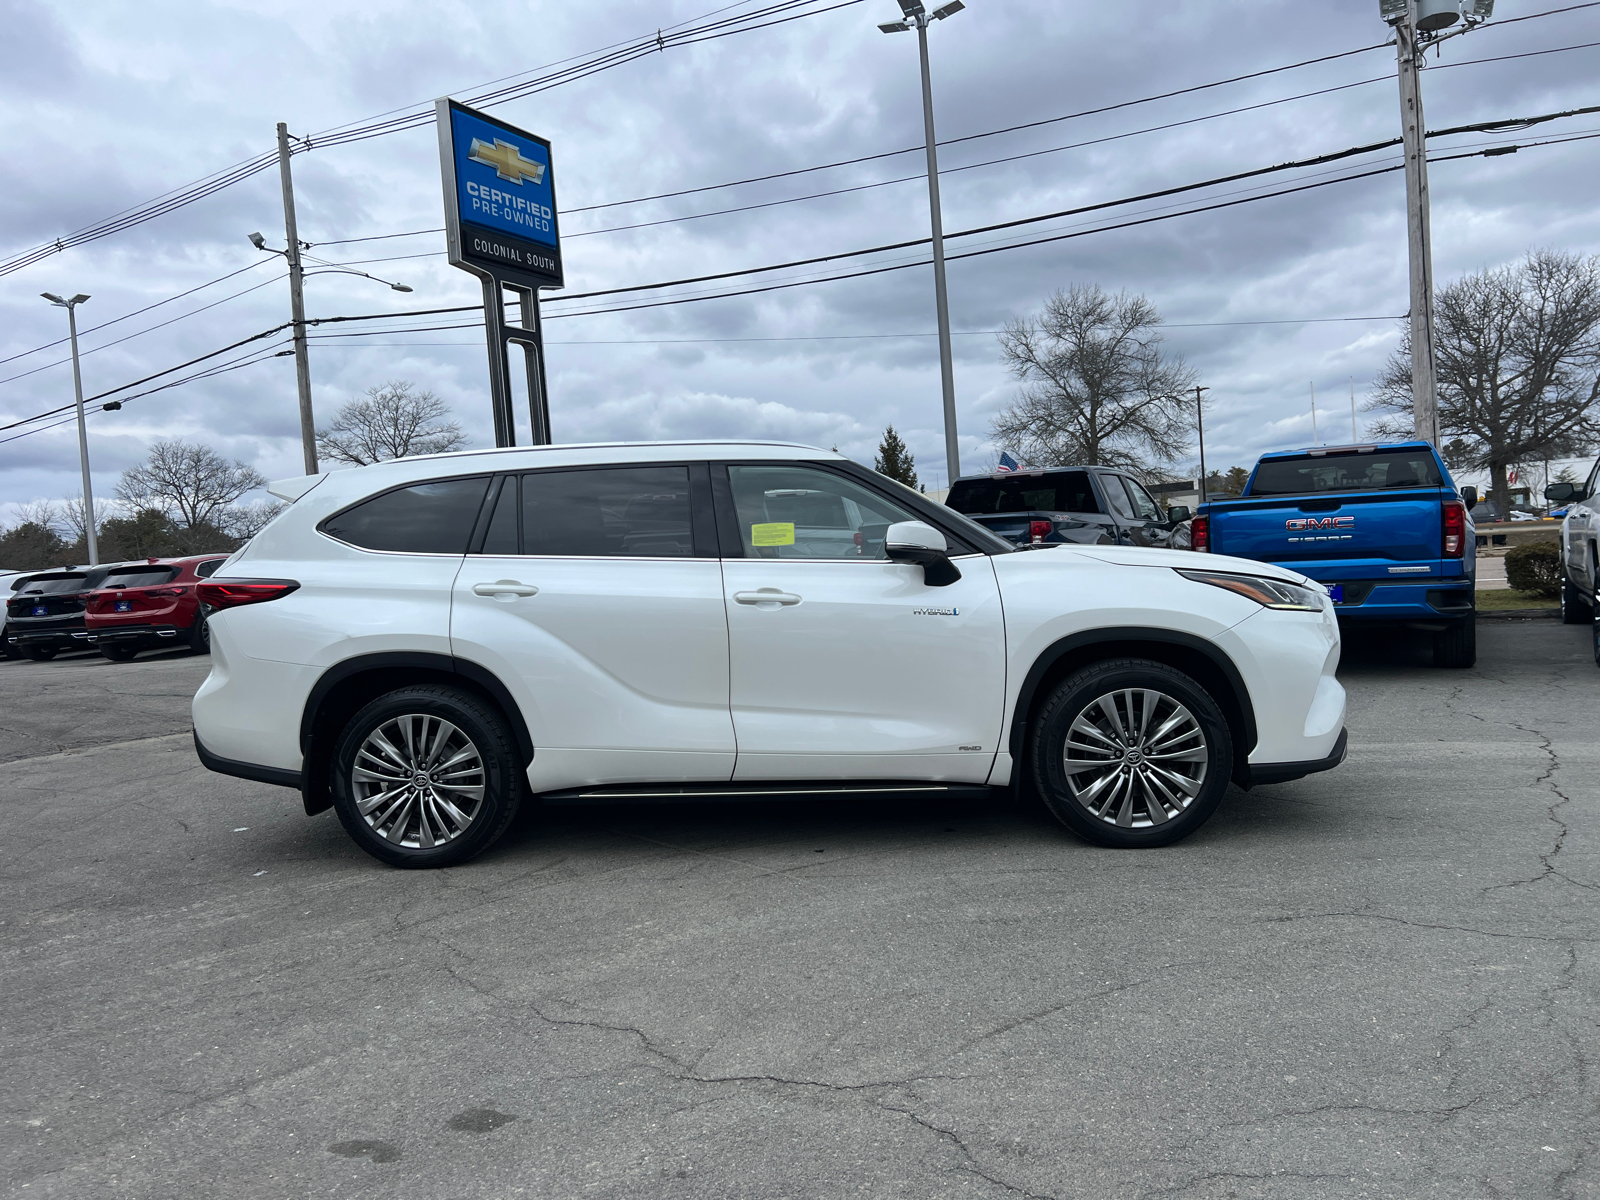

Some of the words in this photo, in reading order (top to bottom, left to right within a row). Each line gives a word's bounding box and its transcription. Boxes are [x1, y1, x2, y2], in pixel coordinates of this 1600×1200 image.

[466, 181, 552, 220] CERTIFIED
[472, 197, 550, 233] PRE-OWNED
[474, 238, 522, 262] COLONIAL
[526, 252, 555, 271] SOUTH
[1286, 516, 1355, 531] GMC
[1287, 535, 1353, 543] SIERRA
[913, 608, 953, 616] HYBRID
